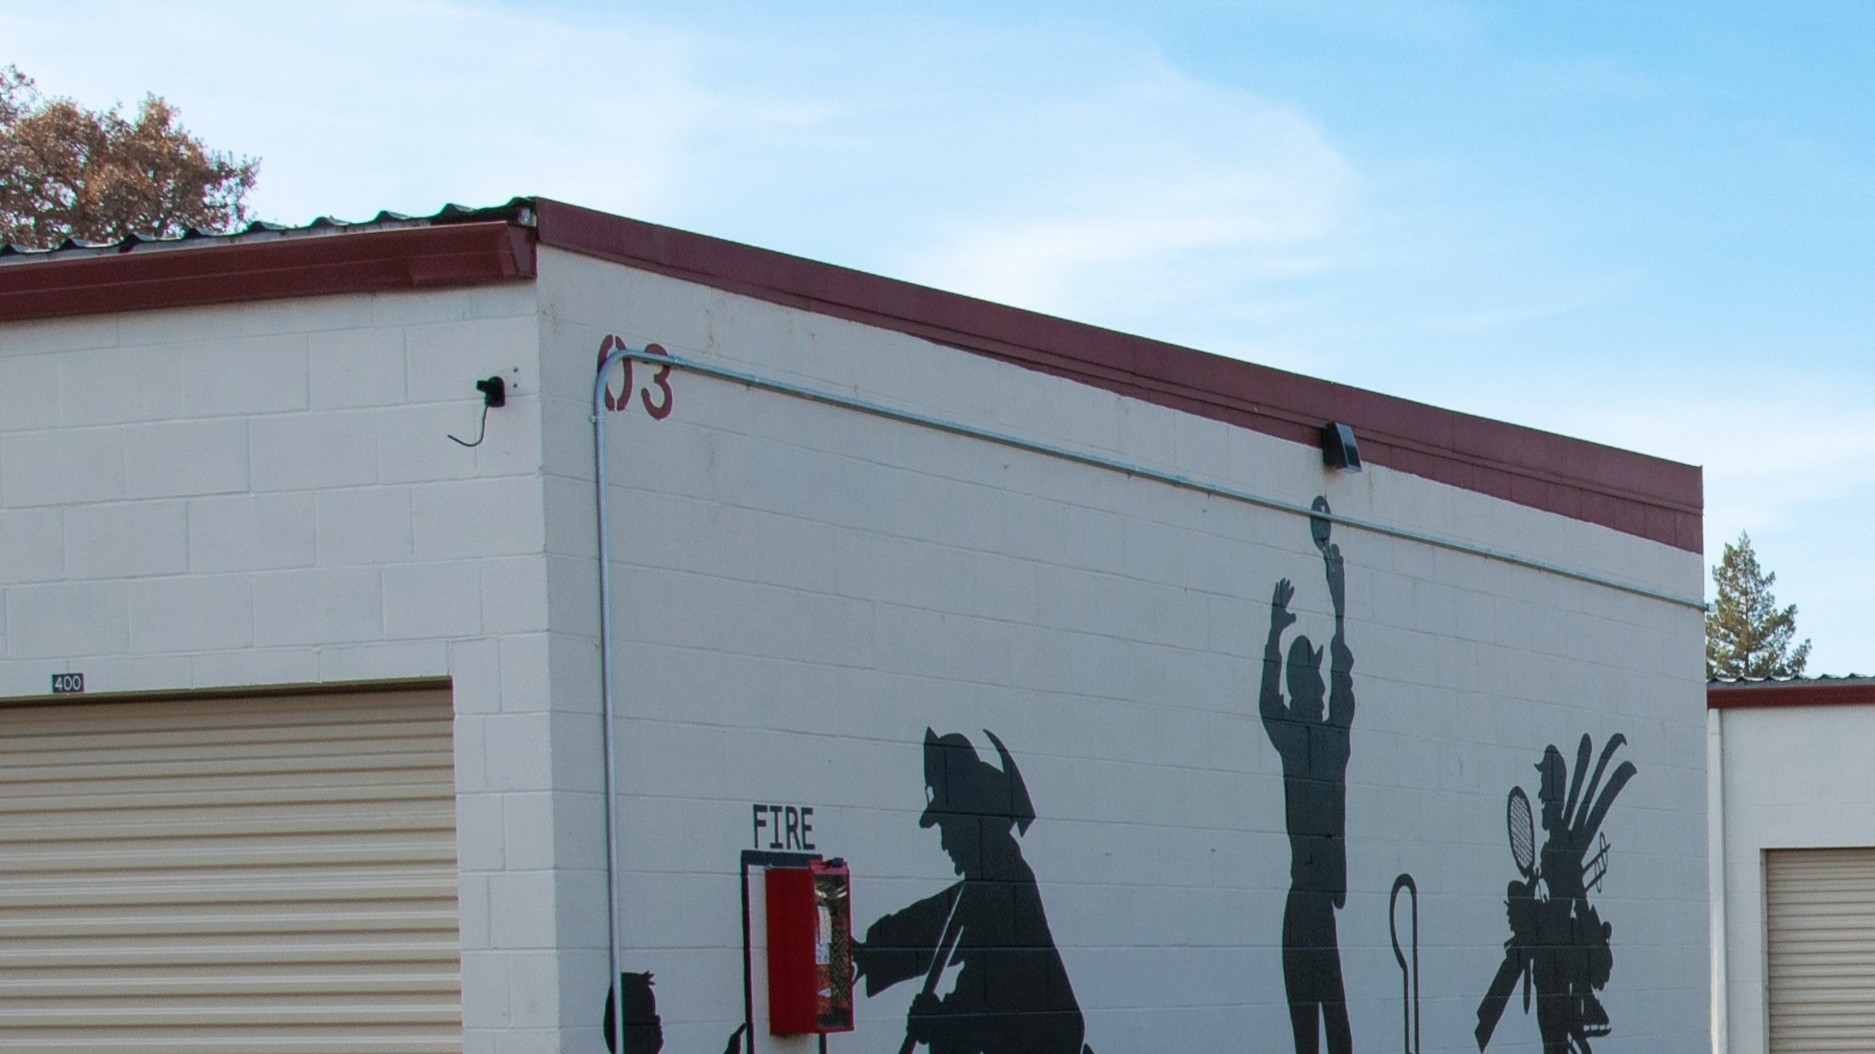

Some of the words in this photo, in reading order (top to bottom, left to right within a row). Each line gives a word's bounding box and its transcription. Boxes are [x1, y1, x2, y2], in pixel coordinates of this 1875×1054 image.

[597, 334, 672, 420] 03
[55, 675, 81, 691] 400
[753, 804, 815, 850] FIRE
